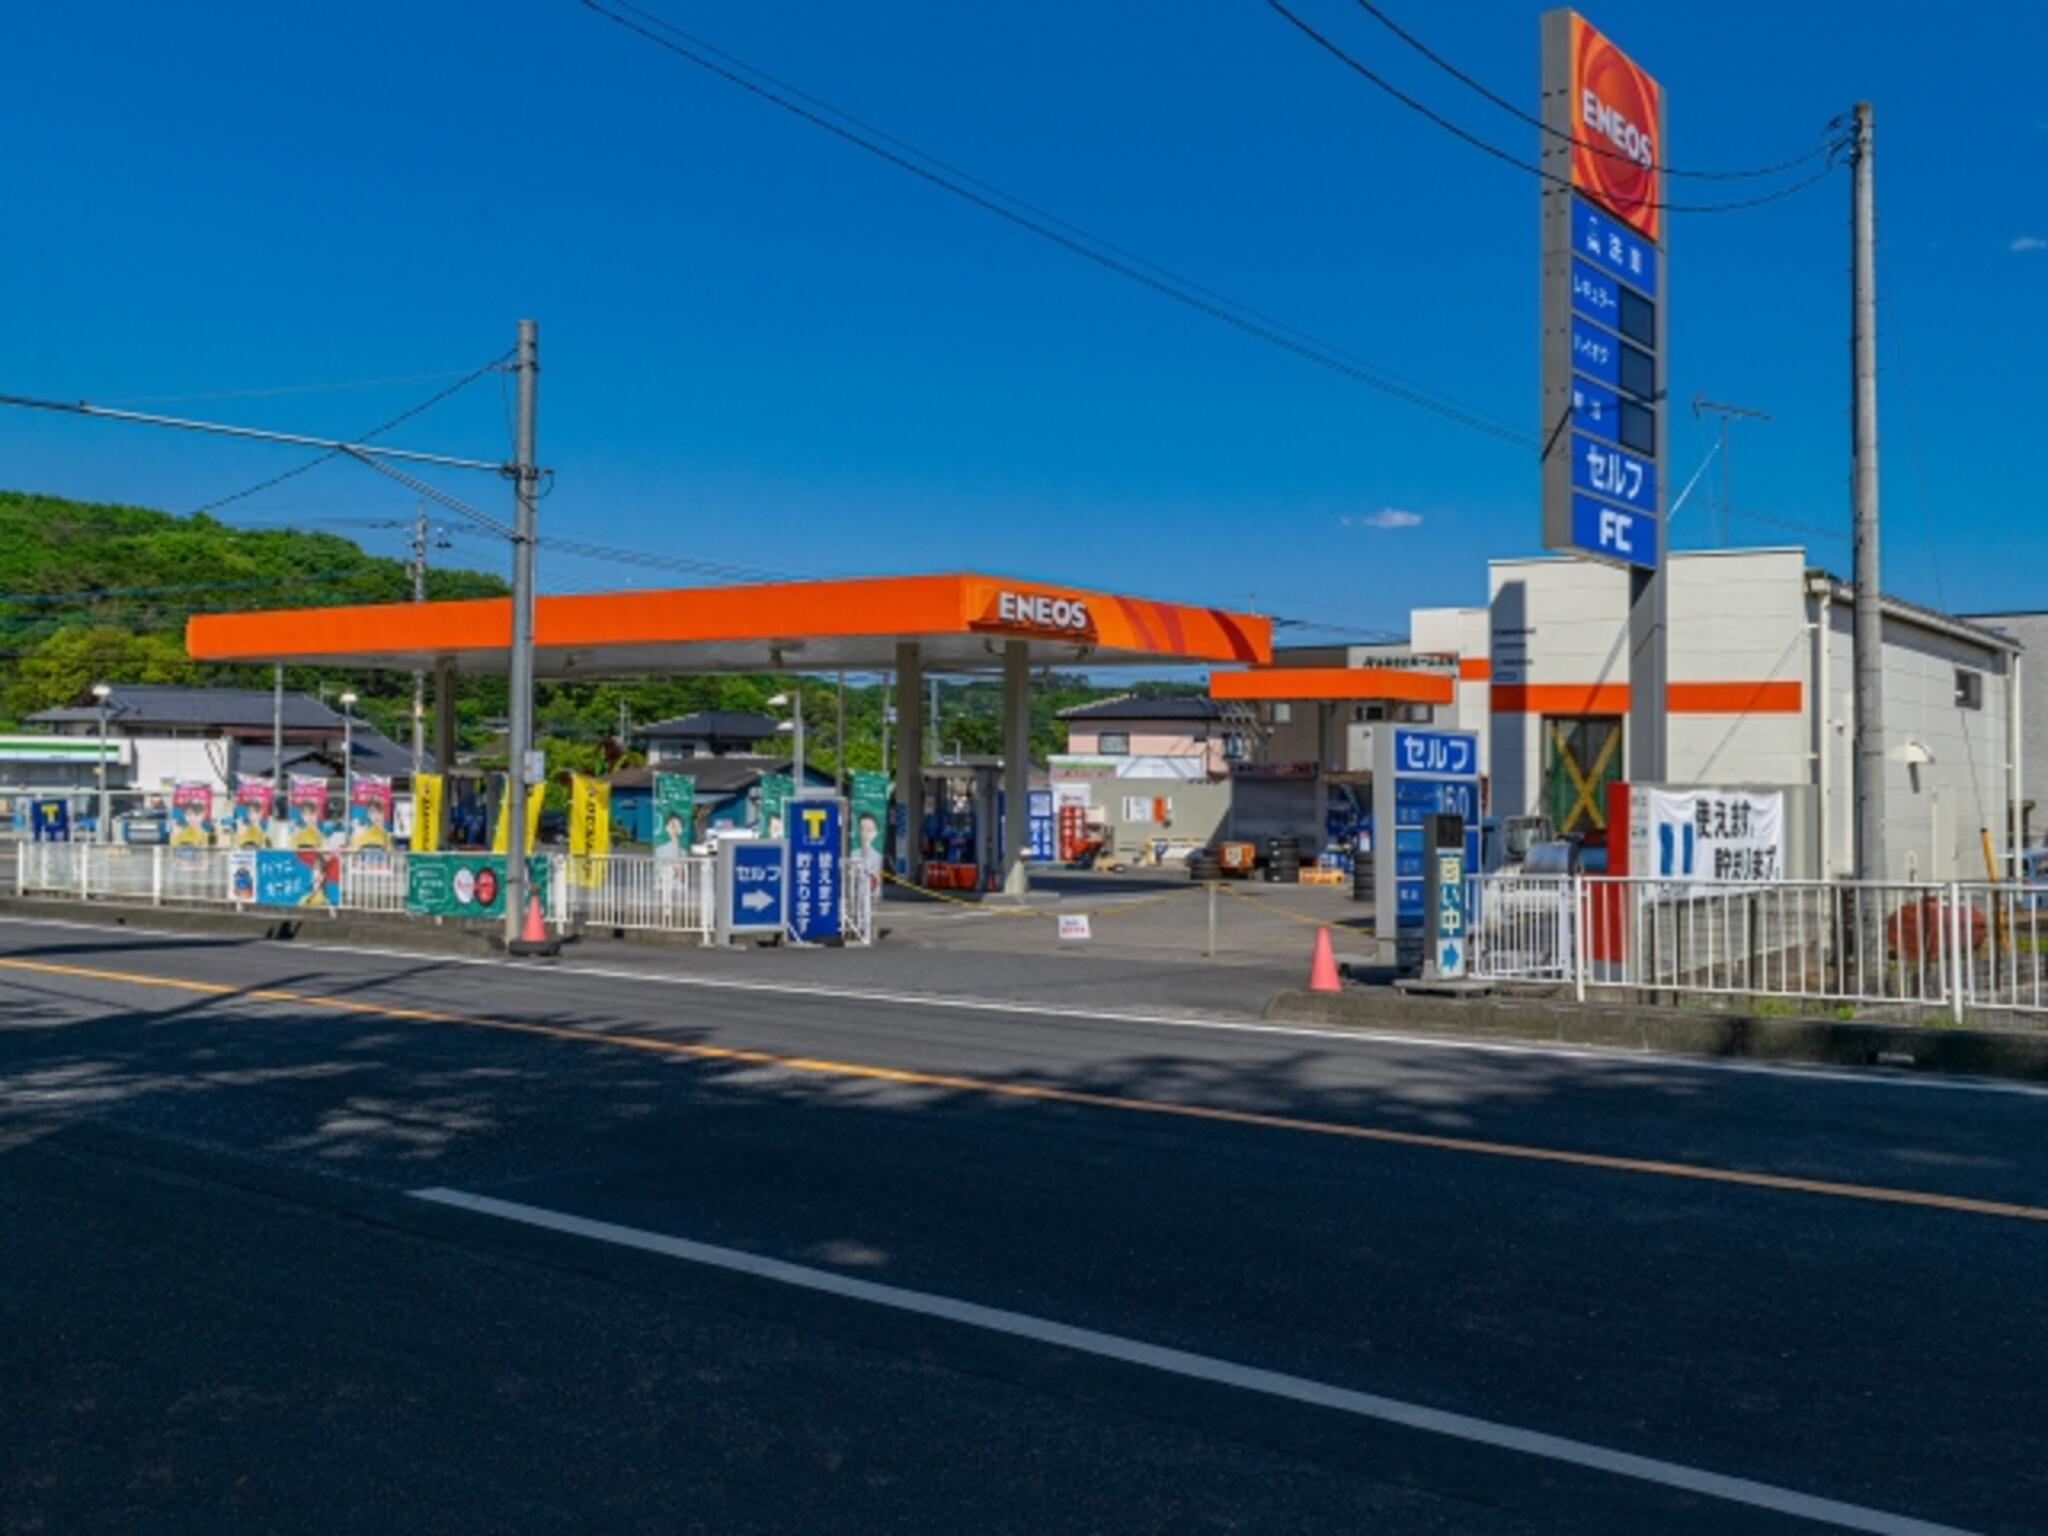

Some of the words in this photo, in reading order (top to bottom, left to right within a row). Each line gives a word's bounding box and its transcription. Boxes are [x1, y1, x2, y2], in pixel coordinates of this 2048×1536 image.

[1581, 87, 1653, 170] ENEOS
[1586, 444, 1643, 499] セルフ
[1599, 508, 1633, 552] FC
[999, 591, 1089, 629] ENEOS
[1403, 734, 1471, 771] セルフ
[802, 809, 827, 840] T
[735, 866, 781, 882] セルフ
